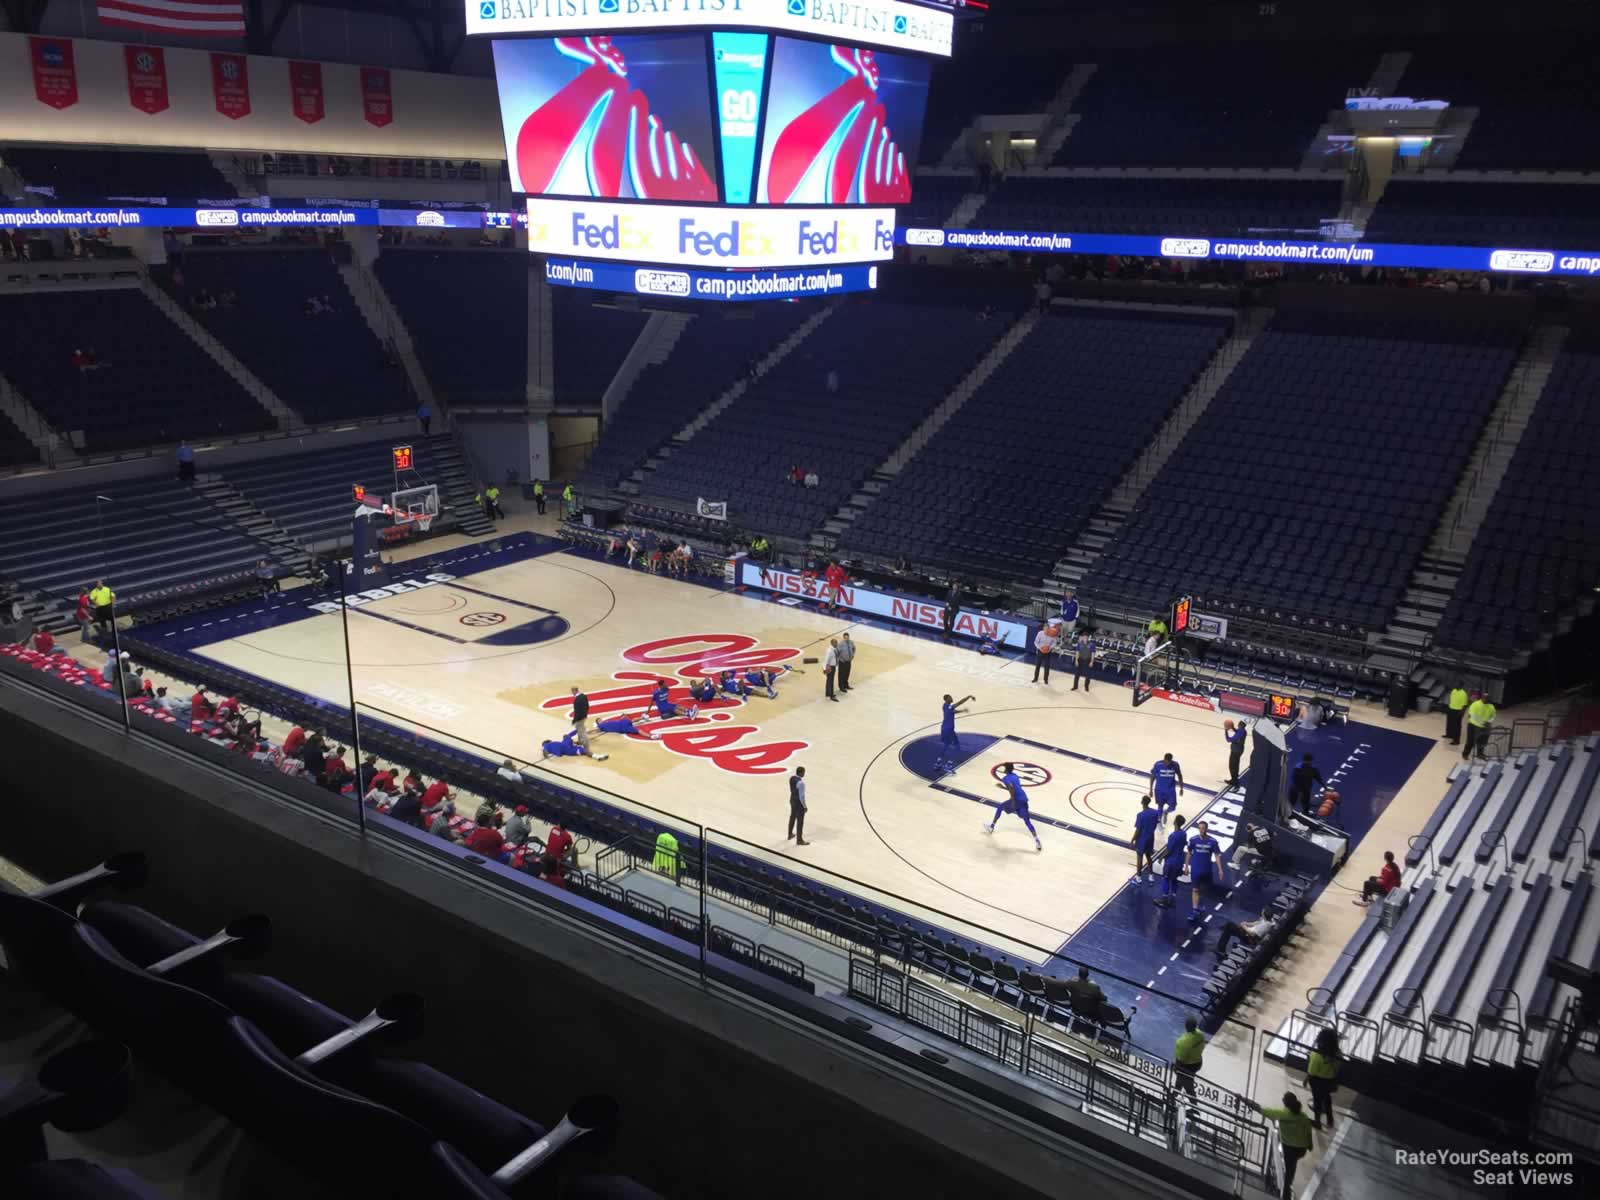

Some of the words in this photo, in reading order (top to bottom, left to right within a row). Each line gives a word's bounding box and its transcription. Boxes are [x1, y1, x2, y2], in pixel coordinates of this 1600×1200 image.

[811, 0, 889, 33] BAPTIST
[722, 88, 757, 121] GO
[242, 210, 355, 225] campusbookmart.com/um
[572, 212, 652, 250] FedEx
[678, 218, 775, 257] FedEx
[798, 219, 858, 255] FedEx
[947, 232, 1071, 250] campusbookmart.com/um
[1214, 241, 1374, 262] campusbookmart.com/um
[546, 261, 593, 284] t.com/um
[696, 269, 843, 298] campusbookmart.com/um
[307, 572, 456, 615] REBELS
